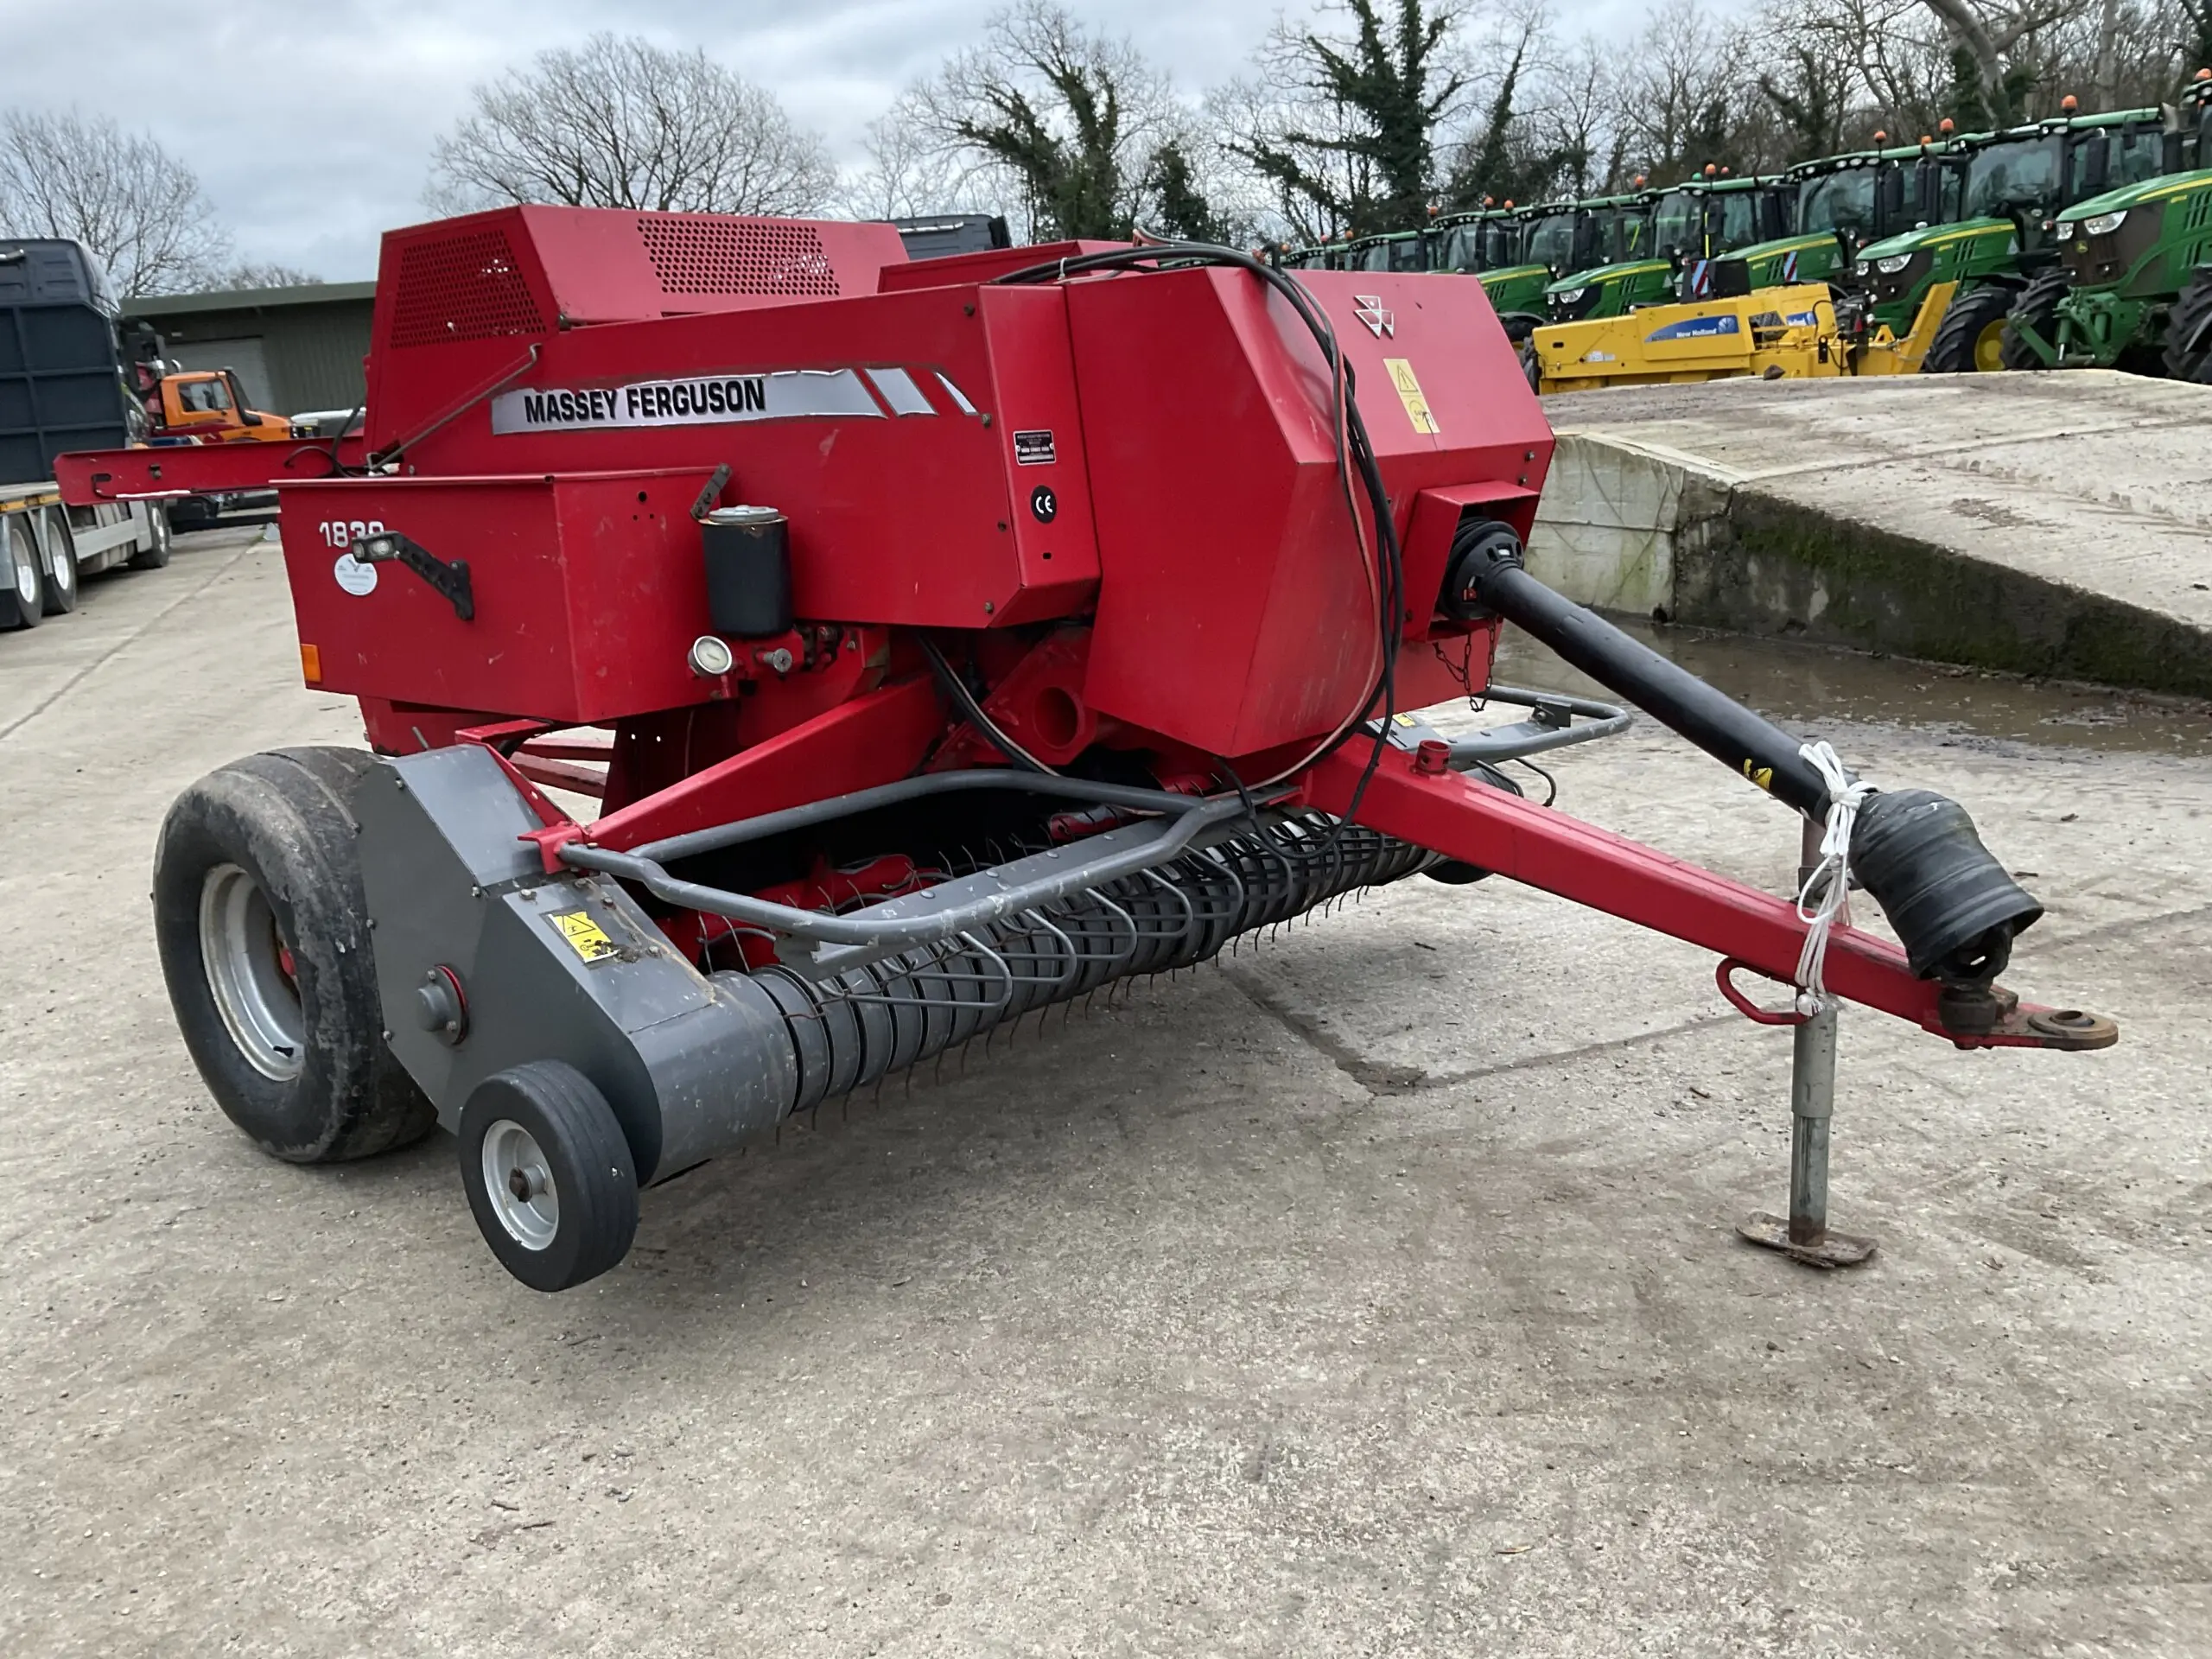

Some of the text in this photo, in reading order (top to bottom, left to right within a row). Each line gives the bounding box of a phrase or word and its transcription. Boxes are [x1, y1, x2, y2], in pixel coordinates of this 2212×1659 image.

[1692, 327, 1717, 337] Holland
[524, 378, 766, 423] MASSEY FERGUSON
[1035, 495, 1053, 514] CE
